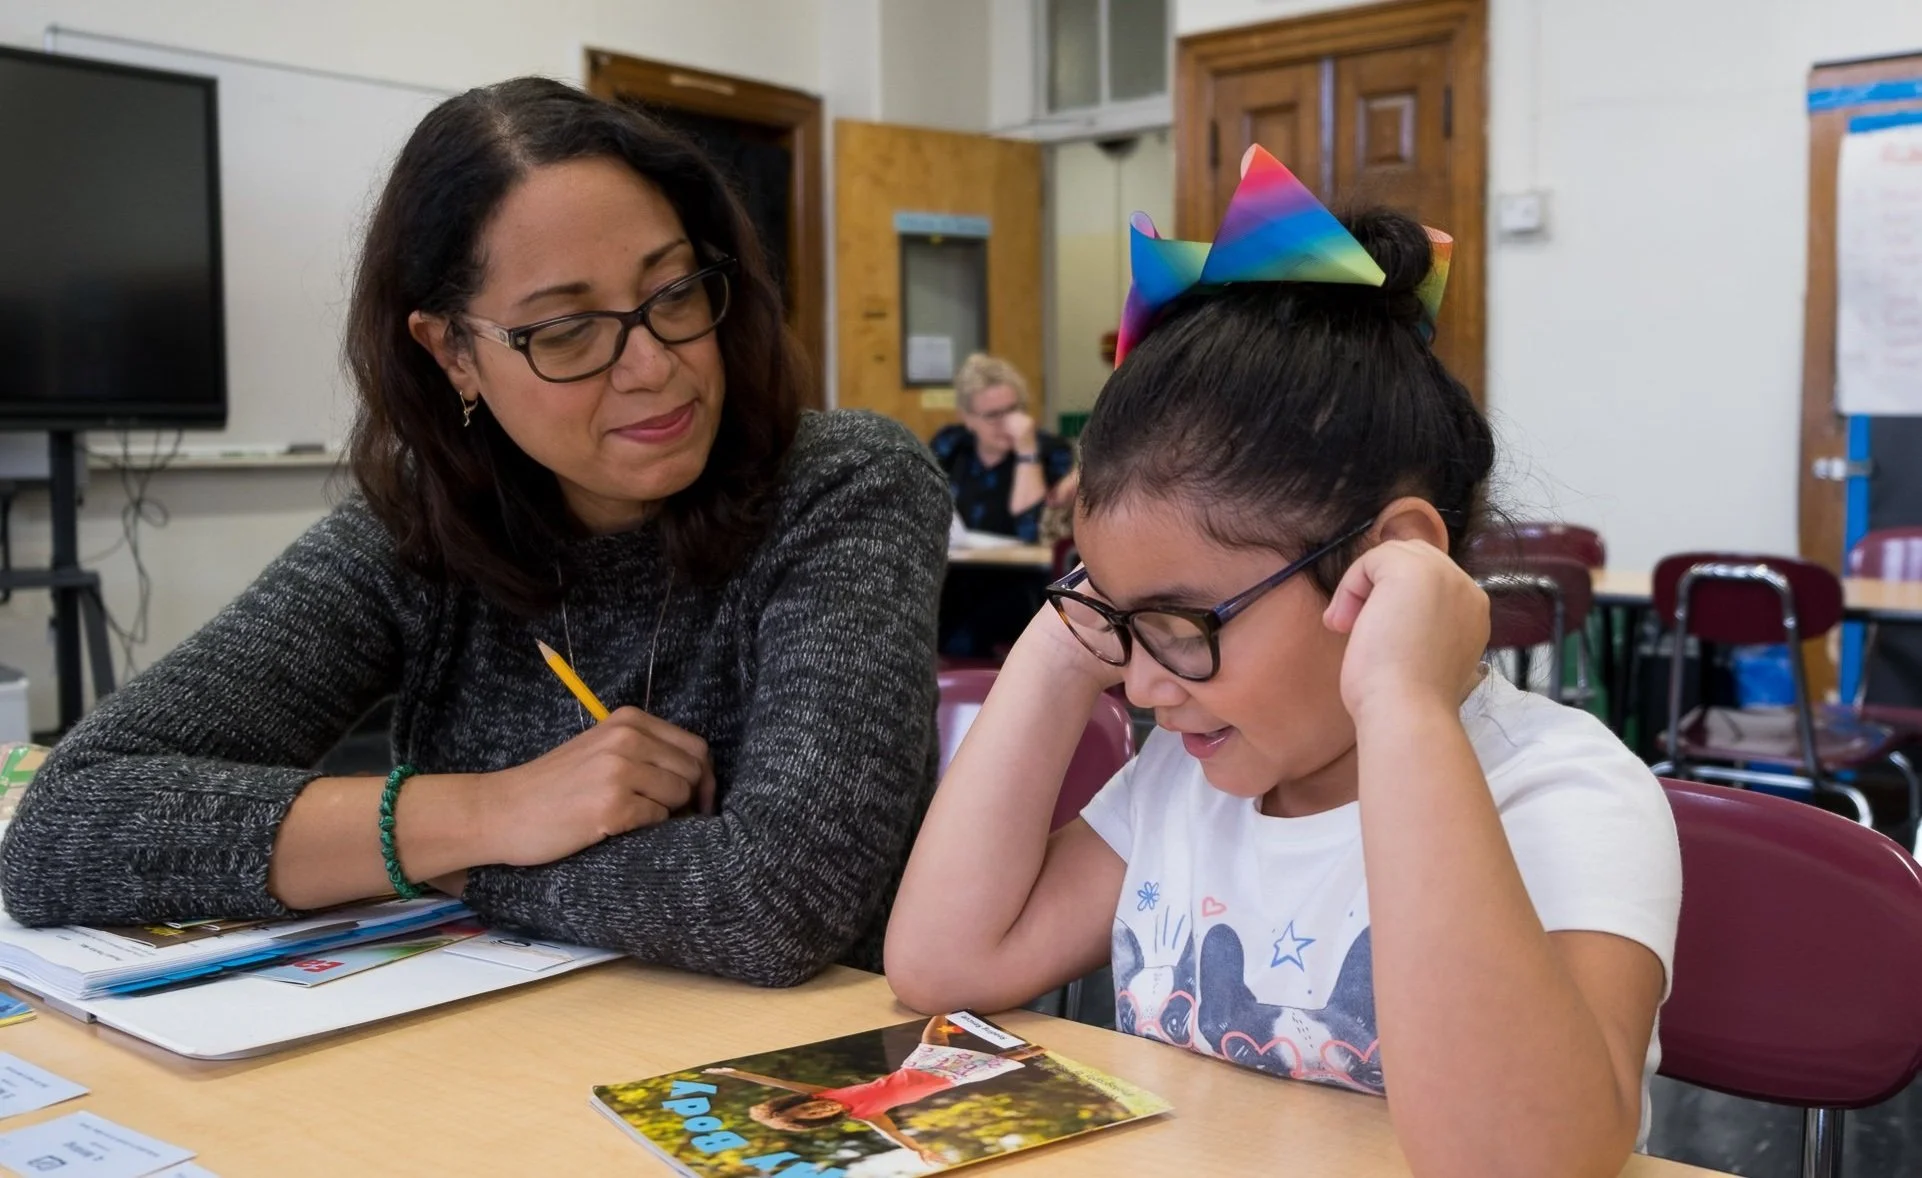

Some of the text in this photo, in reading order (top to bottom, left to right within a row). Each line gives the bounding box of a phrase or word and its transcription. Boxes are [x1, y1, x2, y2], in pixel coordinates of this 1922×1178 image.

[960, 1014, 1008, 1041] Reading Rescue
[661, 1079, 749, 1154] Body
